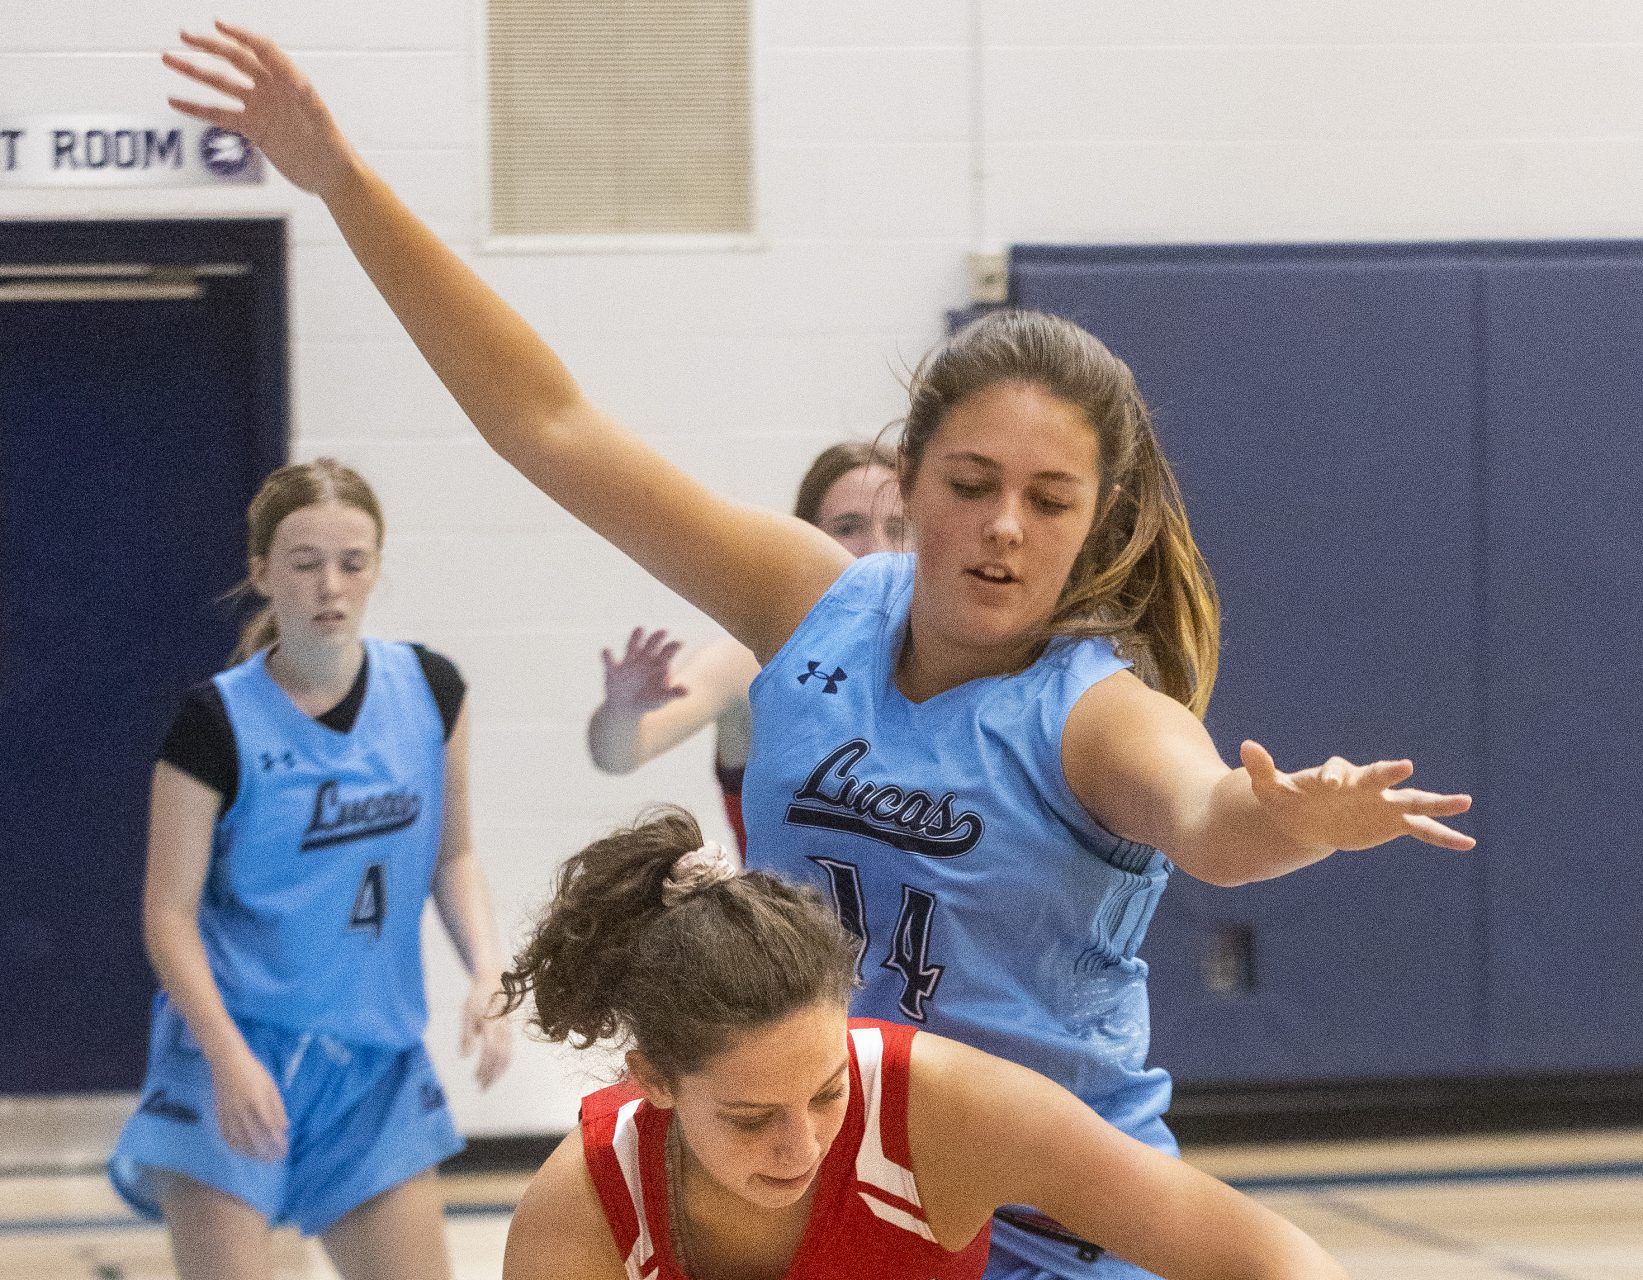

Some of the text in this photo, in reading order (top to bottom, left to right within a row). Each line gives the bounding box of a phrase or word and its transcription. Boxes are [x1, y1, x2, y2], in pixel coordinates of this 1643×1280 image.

[52, 129, 183, 171] ROOM
[788, 738, 974, 849] Lucas
[347, 859, 388, 942] 4
[806, 856, 946, 1024] 14
